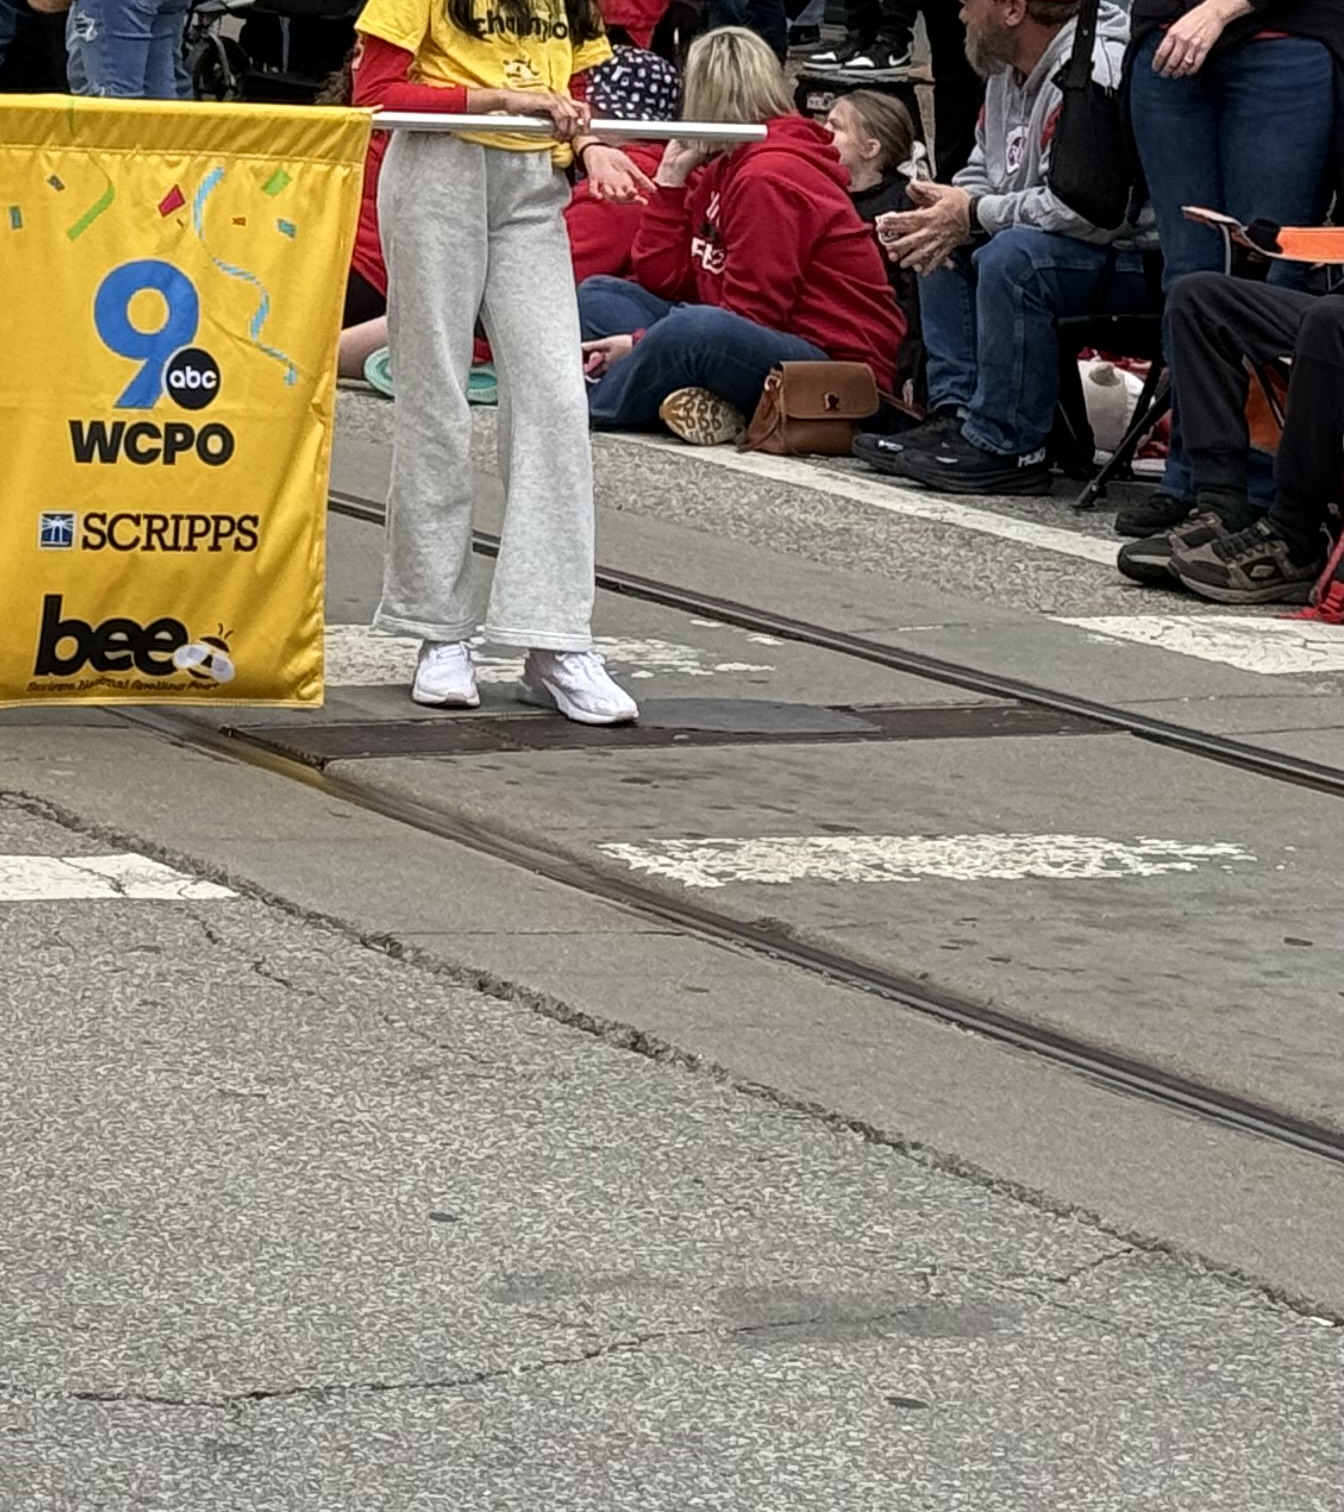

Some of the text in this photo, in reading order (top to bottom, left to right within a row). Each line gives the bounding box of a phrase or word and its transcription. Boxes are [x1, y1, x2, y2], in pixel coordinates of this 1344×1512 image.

[93, 258, 200, 409] 9
[169, 362, 219, 390] abc
[68, 419, 236, 466] WCPO
[81, 512, 260, 553] SCRIPPS
[33, 593, 189, 677] bee
